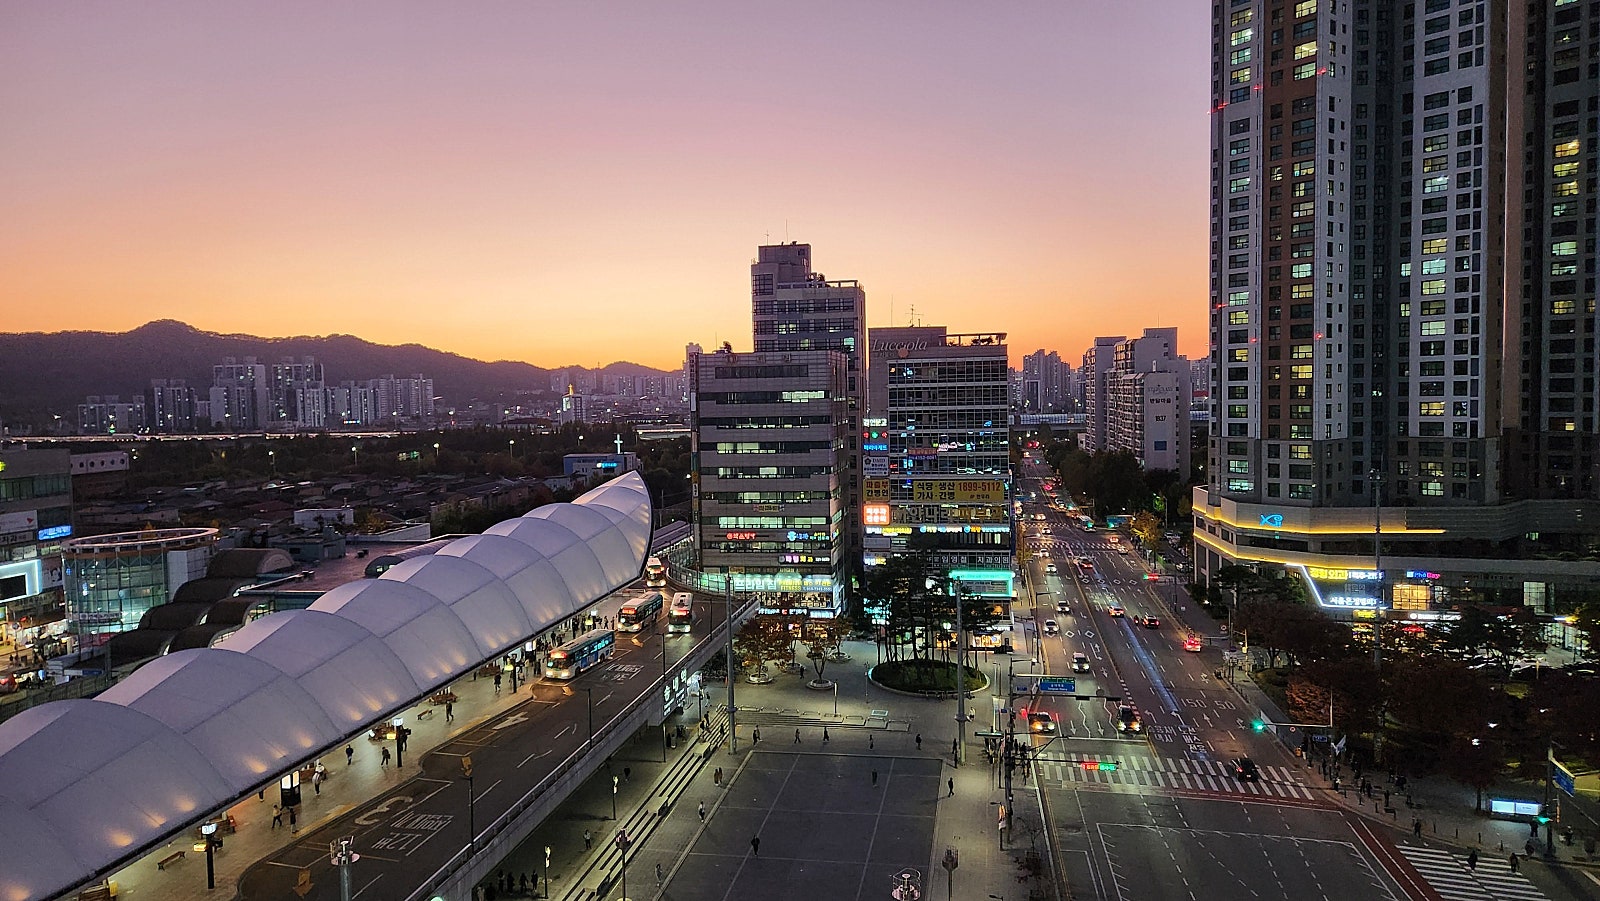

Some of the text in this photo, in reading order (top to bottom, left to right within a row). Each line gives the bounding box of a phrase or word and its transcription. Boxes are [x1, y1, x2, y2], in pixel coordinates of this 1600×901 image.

[872, 337, 928, 351] Lucciola
[958, 482, 1000, 492] 1899-5112
[1214, 700, 1236, 710] 50
